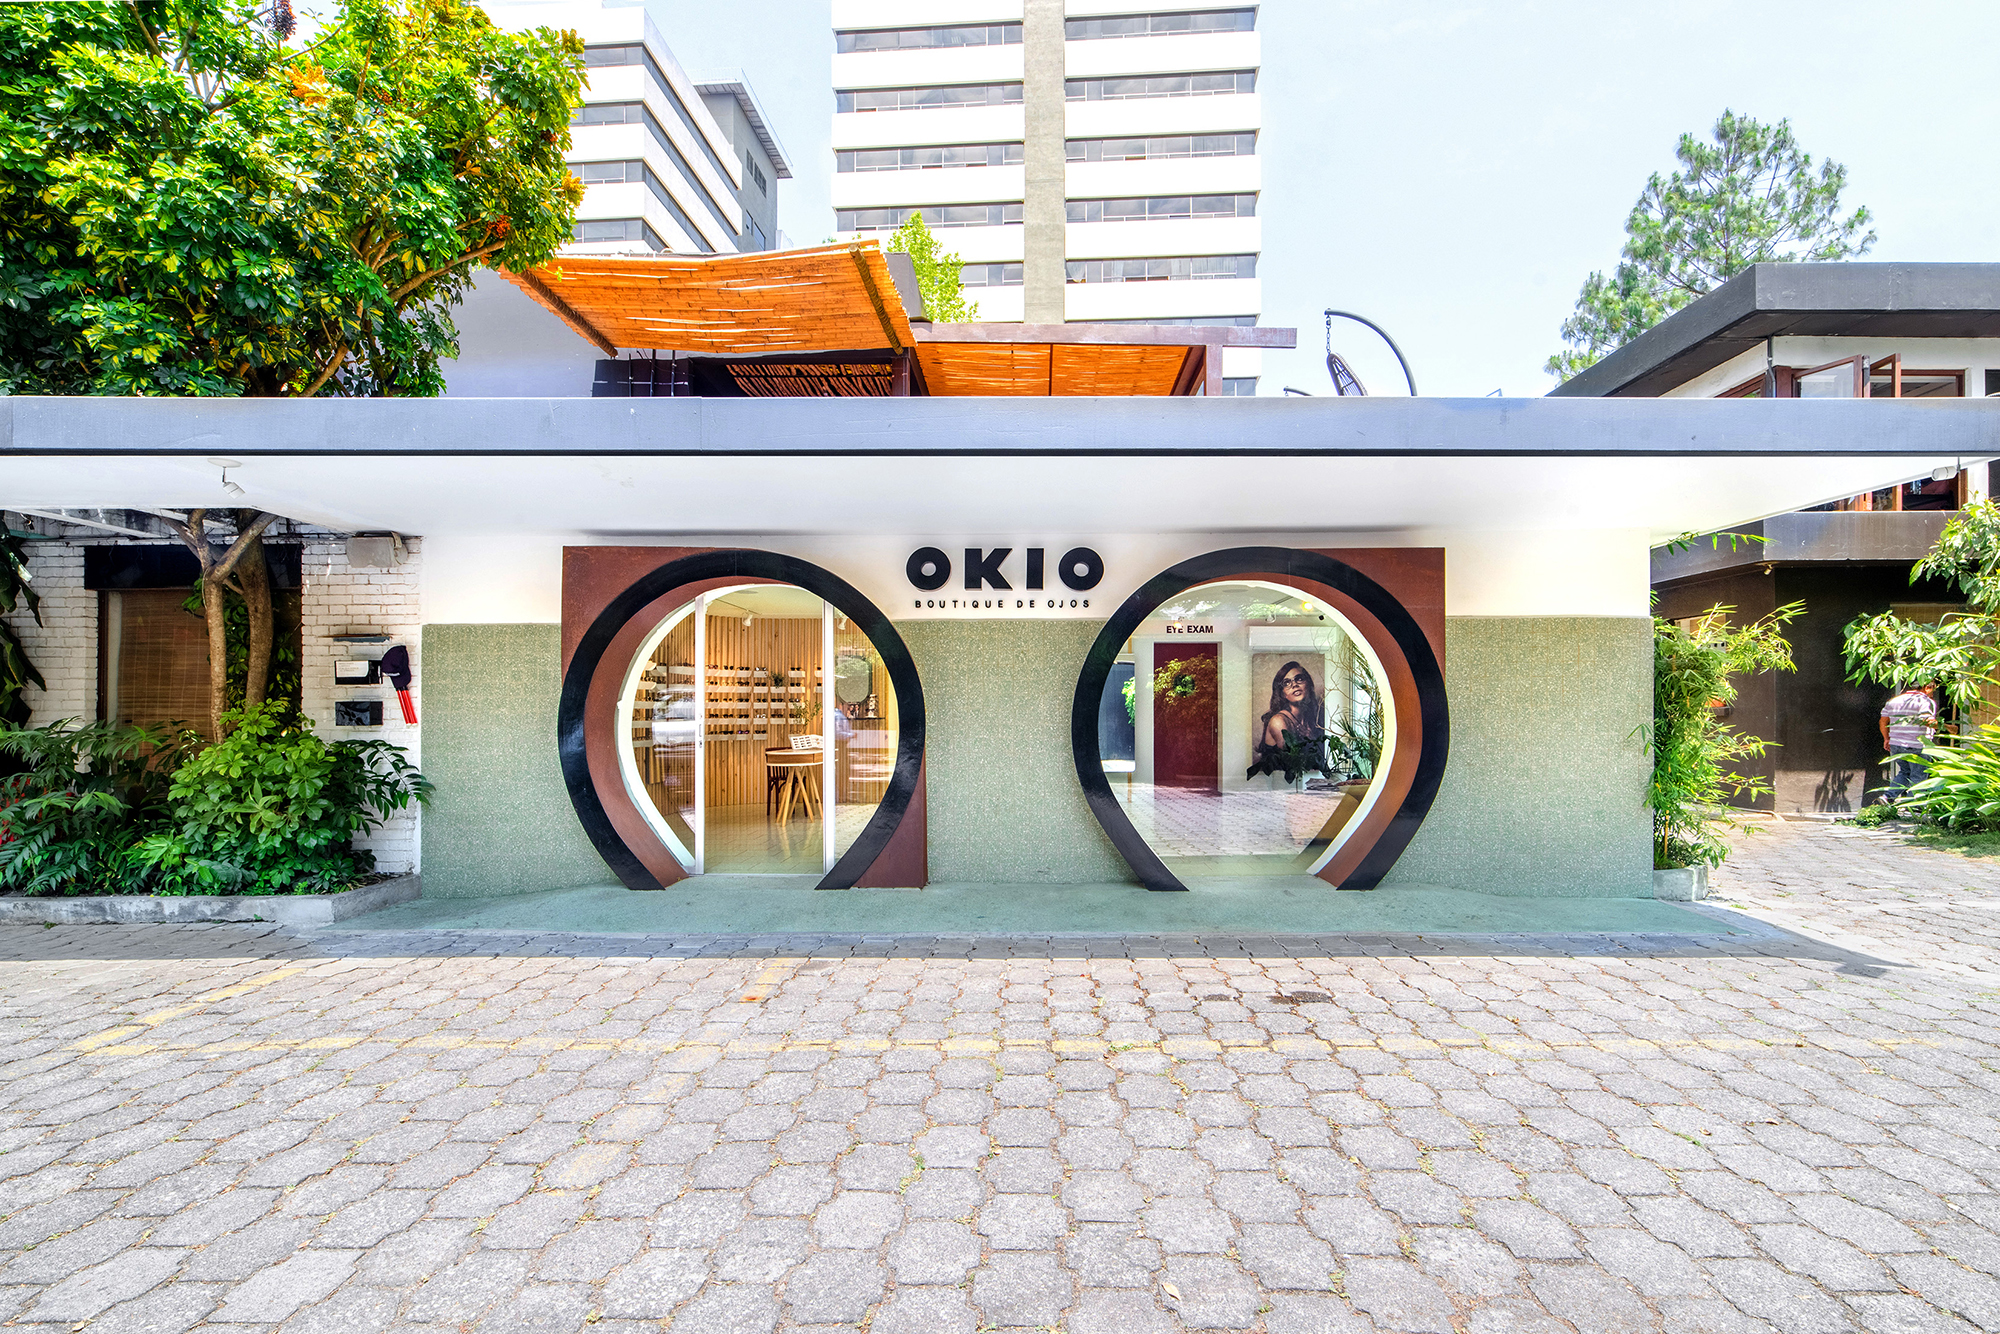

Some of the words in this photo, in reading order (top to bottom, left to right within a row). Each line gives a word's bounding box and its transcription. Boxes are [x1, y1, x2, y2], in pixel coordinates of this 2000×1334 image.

[906, 546, 1105, 592] OKIO
[915, 600, 1004, 609] BOUTIQUE
[1016, 600, 1035, 609] DE
[1047, 600, 1090, 608] OJOS
[1187, 625, 1214, 634] EXAM
